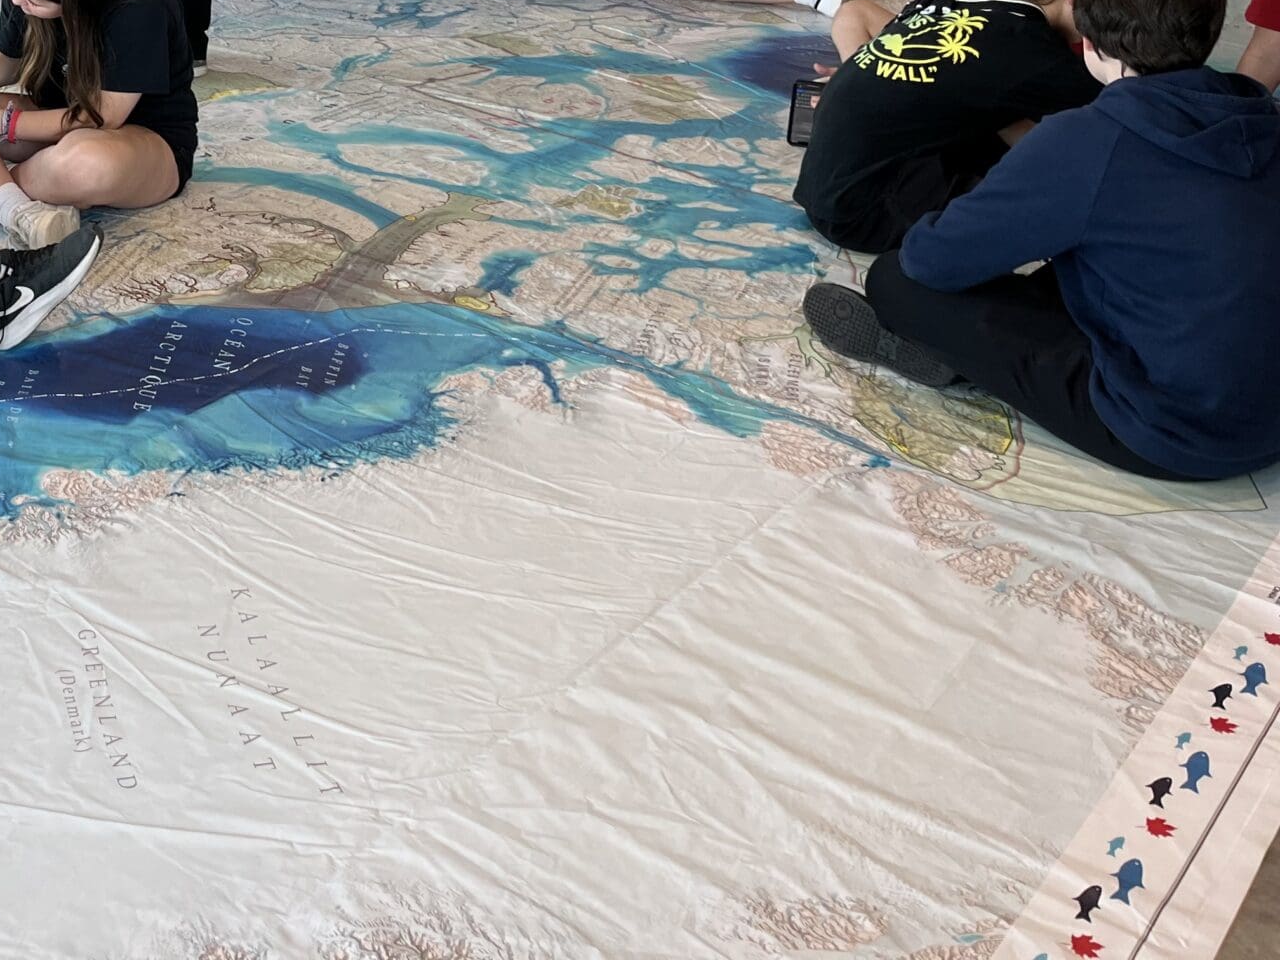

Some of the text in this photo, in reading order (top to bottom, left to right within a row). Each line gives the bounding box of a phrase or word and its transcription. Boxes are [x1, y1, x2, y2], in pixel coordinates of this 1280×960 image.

[132, 320, 188, 414] ARCTIQUE
[324, 342, 350, 386] BAFFIN
[77, 628, 138, 790] GREENLAND
